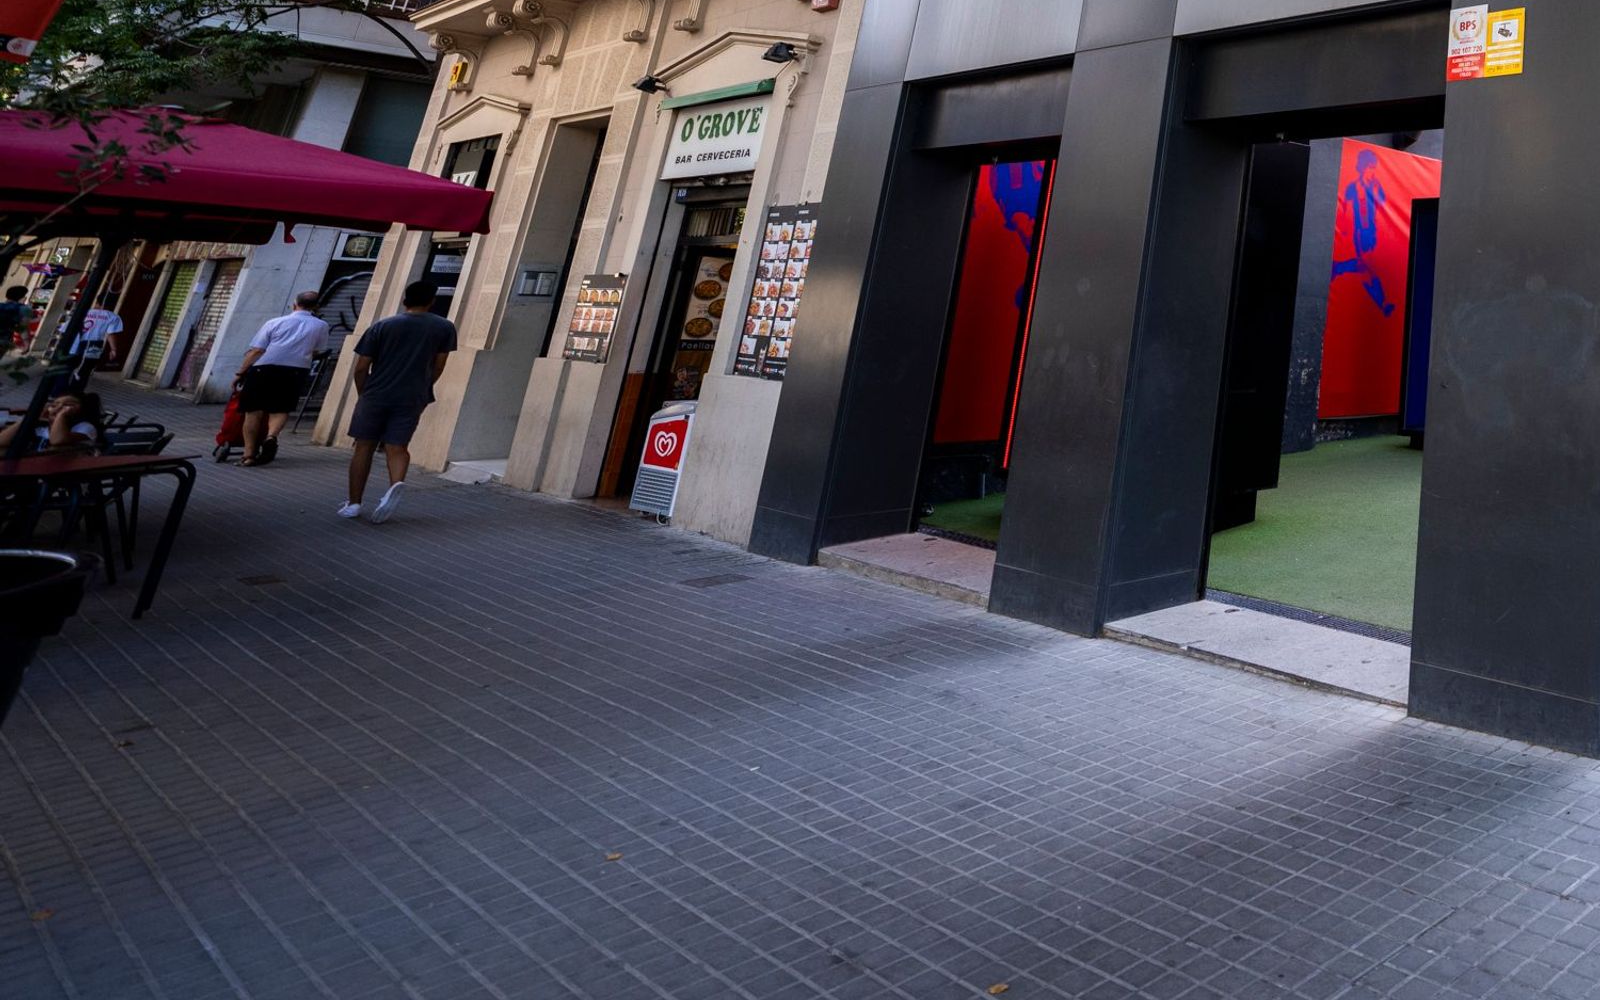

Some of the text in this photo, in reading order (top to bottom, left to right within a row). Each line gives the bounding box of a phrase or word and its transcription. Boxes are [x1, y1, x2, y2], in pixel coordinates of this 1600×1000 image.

[1459, 20, 1477, 32] BPS
[675, 148, 751, 164] BAR CERVECERIA
